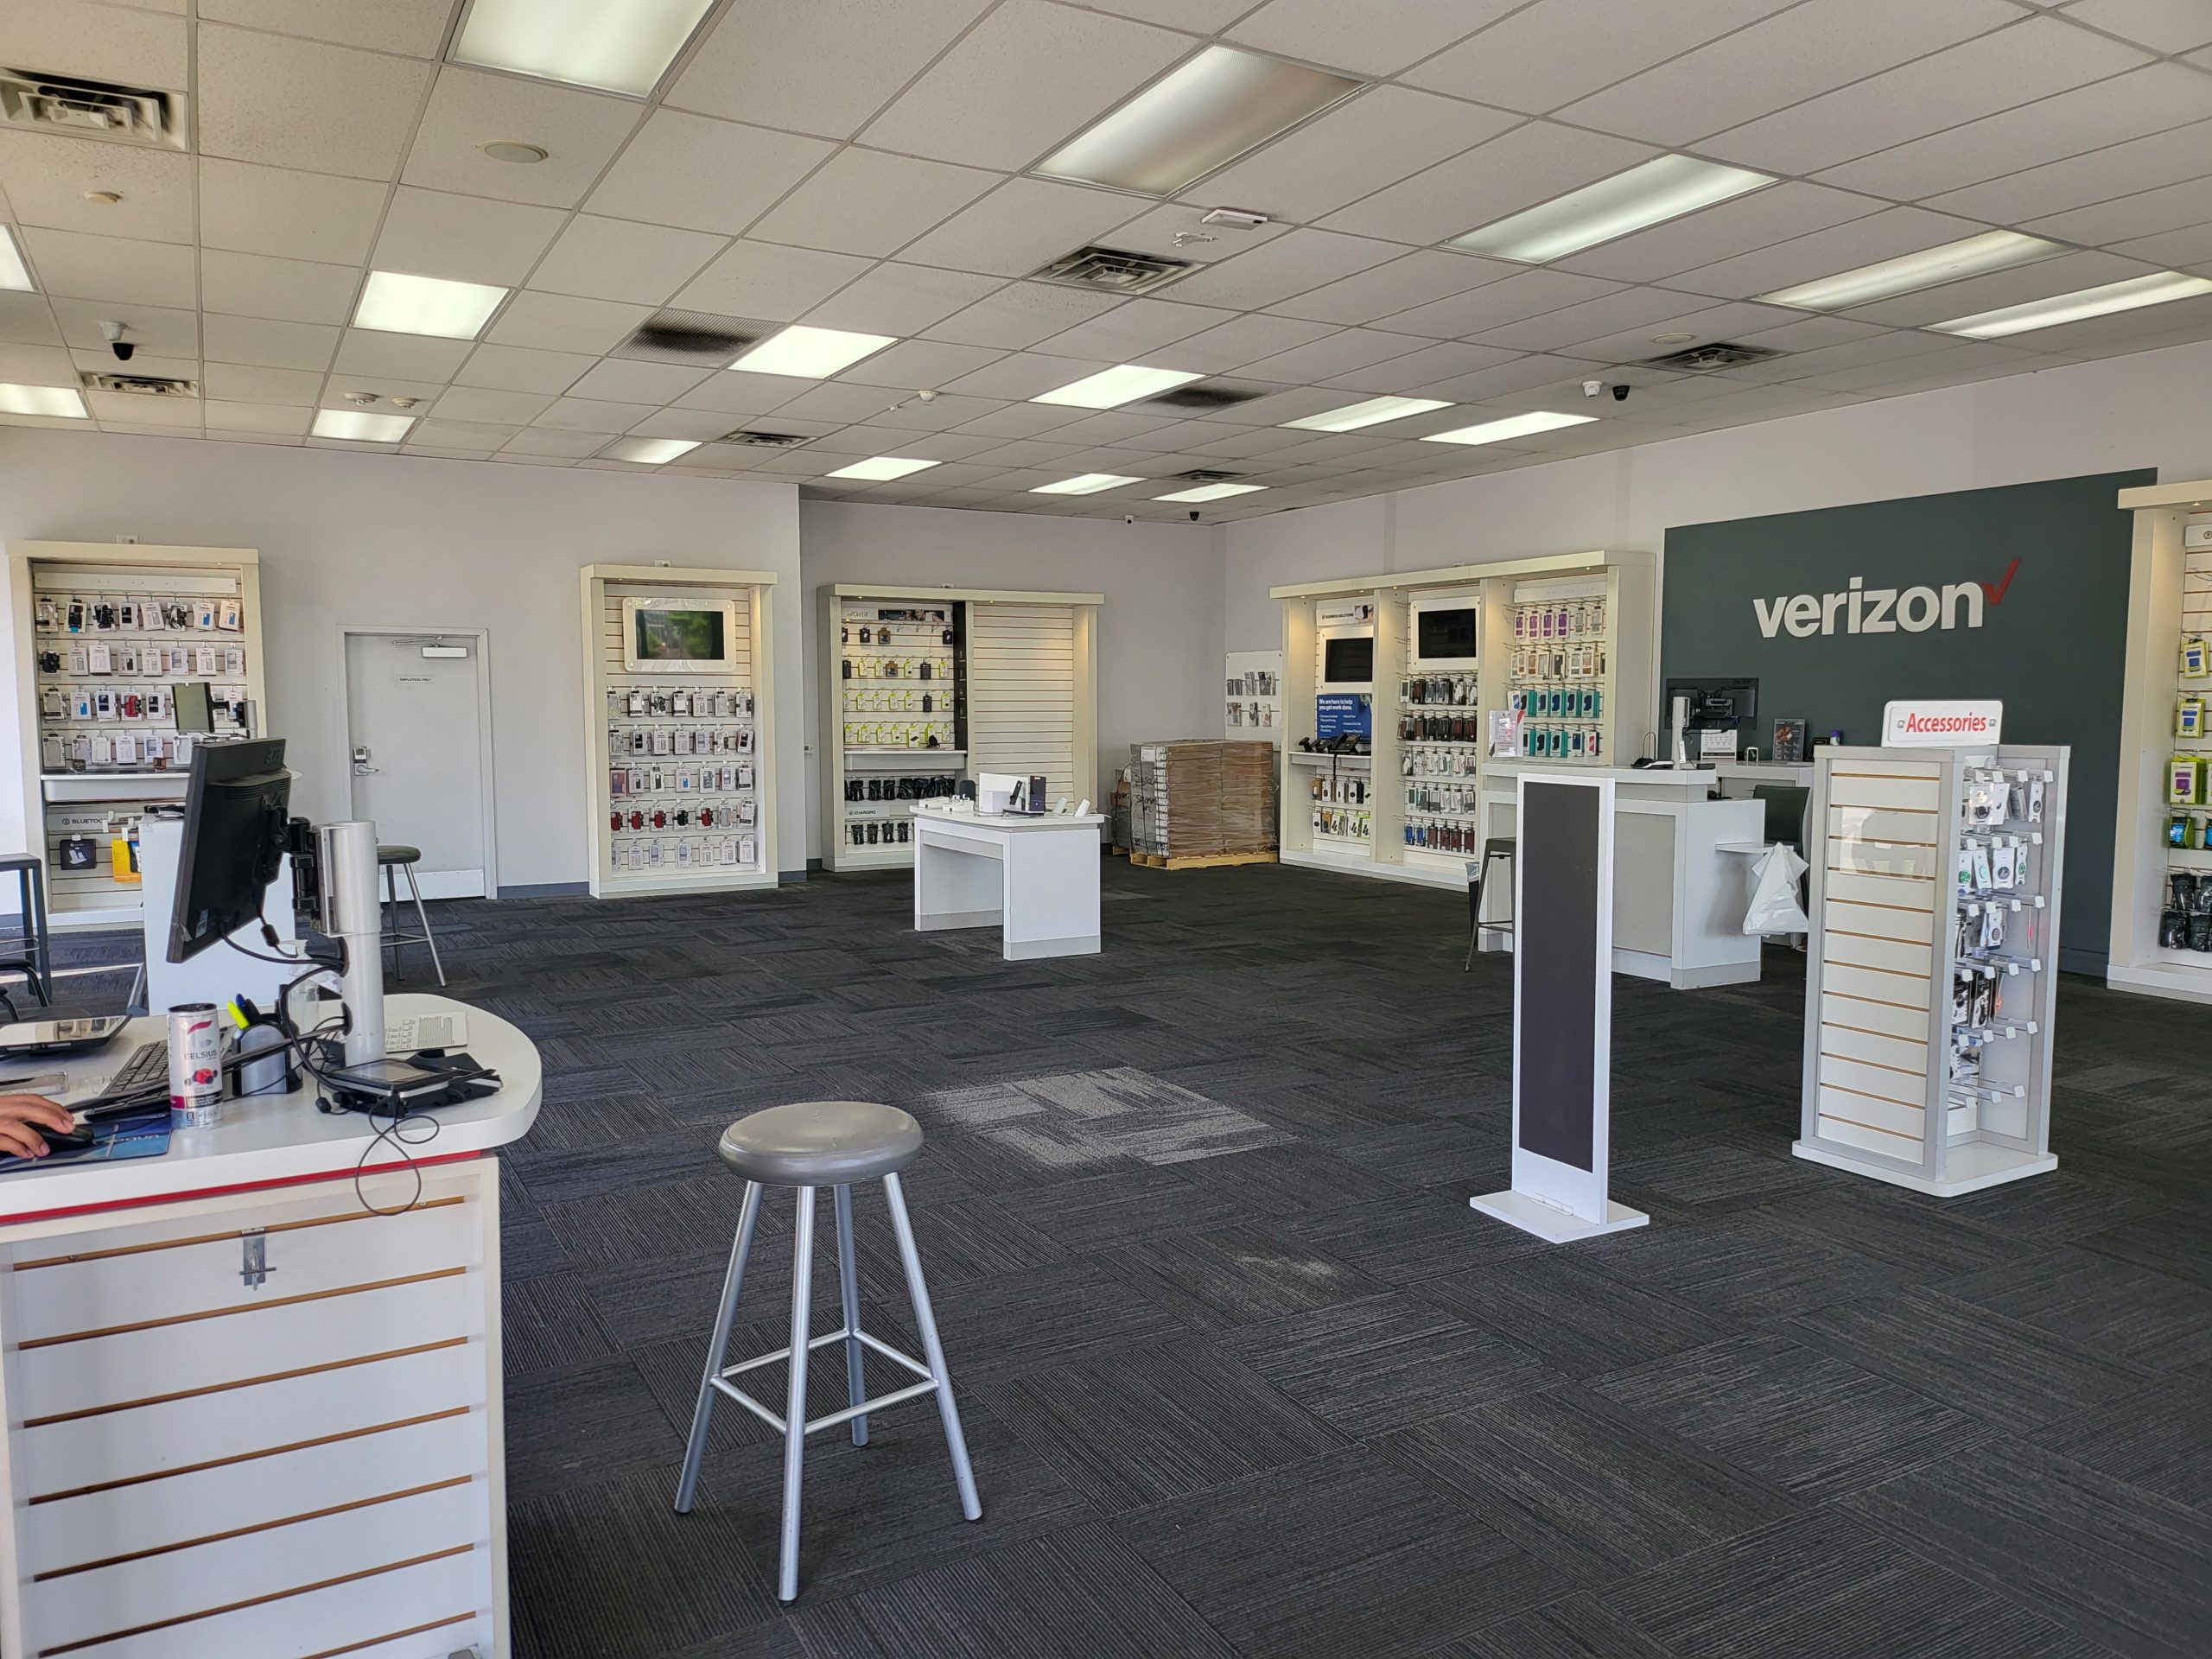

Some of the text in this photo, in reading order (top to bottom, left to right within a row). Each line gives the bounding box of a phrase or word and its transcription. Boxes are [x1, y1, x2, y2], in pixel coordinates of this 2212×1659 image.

[1752, 576, 1984, 638] verizon
[1905, 712, 1986, 733] Accessories
[184, 1049, 218, 1060] CELSIUS
